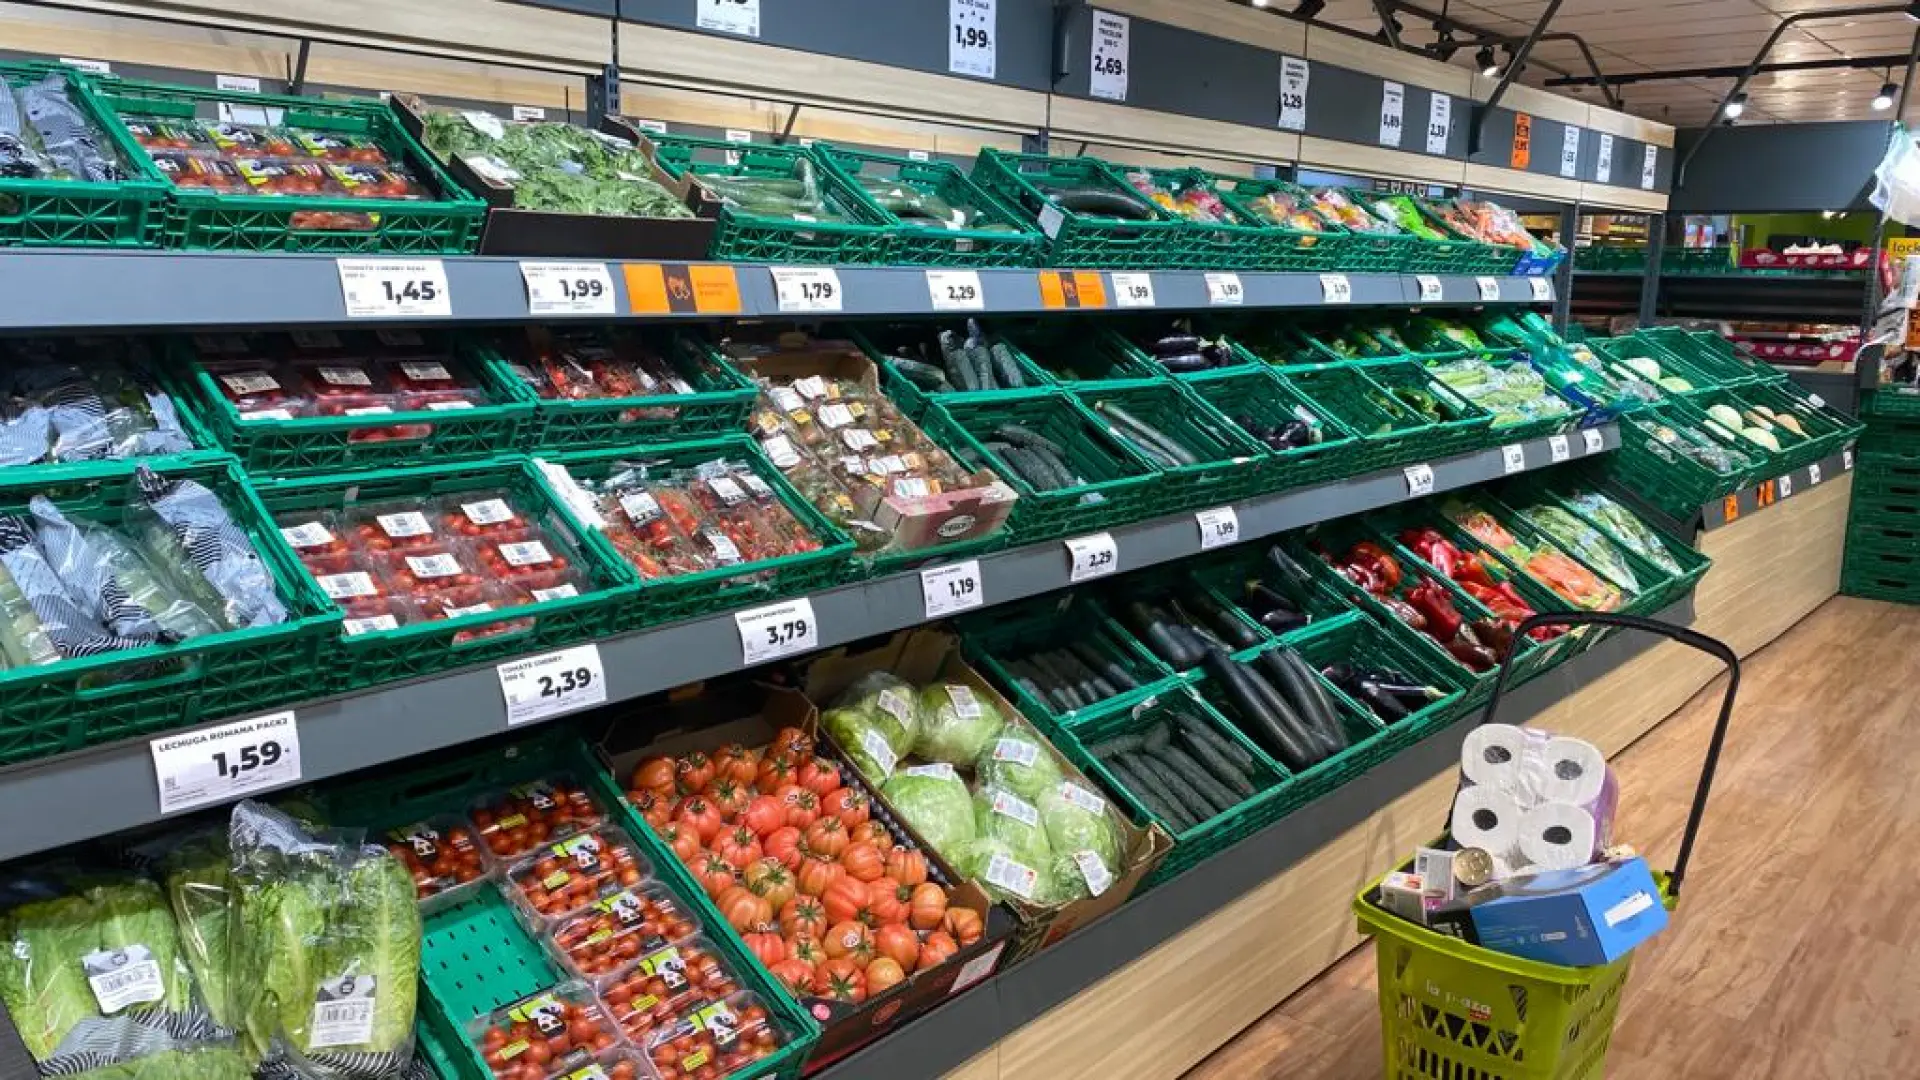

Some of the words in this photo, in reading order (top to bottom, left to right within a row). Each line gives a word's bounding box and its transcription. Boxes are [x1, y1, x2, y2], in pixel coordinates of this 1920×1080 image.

[954, 24, 987, 49] 1,99
[1094, 55, 1122, 75] 2,69
[382, 280, 436, 305] 1,45
[559, 279, 603, 301] 1,99
[801, 283, 832, 302] 1,79
[947, 285, 976, 302] 2,29
[1089, 550, 1112, 567] 2,29
[949, 577, 974, 599] 1,19
[766, 619, 807, 646] 3,79
[537, 667, 592, 699] 2,39
[158, 735, 209, 752] LECHUGA
[209, 725, 256, 741] ROMANA
[211, 740, 283, 779] 1,59
